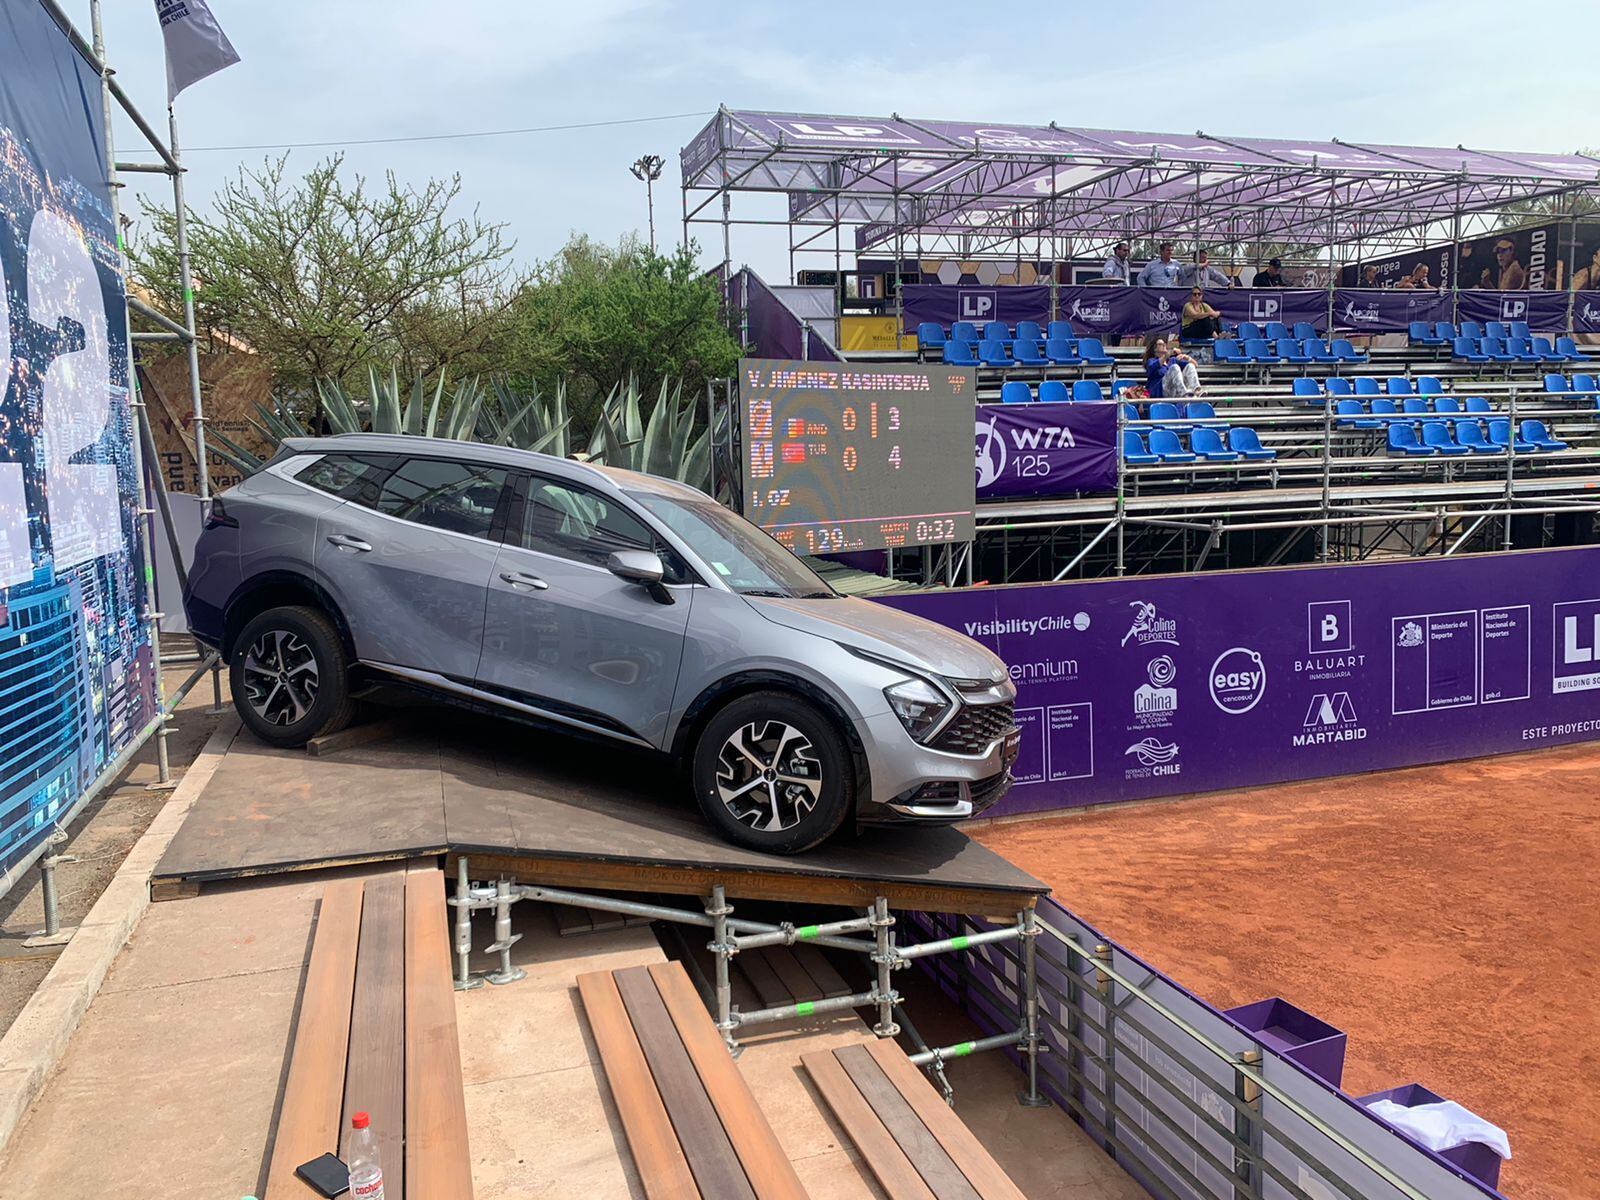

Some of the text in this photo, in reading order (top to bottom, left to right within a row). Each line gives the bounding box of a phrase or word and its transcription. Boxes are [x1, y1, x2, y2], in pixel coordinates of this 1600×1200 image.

[171, 9, 190, 21] CHILE
[790, 123, 884, 137] LP
[963, 297, 992, 316] LP
[1254, 300, 1278, 318] LP
[1503, 301, 1525, 318] LP
[1150, 311, 1178, 321] INDISA
[769, 371, 838, 390] JIMENEZ
[842, 407, 856, 431] 0
[888, 407, 900, 431] 3
[1011, 427, 1075, 449] WTA
[843, 446, 857, 470] 0
[887, 446, 901, 470] 4
[1012, 455, 1050, 477] 125
[767, 489, 790, 507] OZ
[805, 527, 843, 552] 129
[916, 520, 955, 541] 0:32
[964, 615, 1071, 636] VisibilityChile
[1148, 617, 1176, 632] Colina
[1431, 622, 1458, 630] Ministerio
[1485, 621, 1508, 629] Nacional
[1138, 631, 1176, 642] DEPORTES
[1431, 632, 1453, 640] Deporte
[1485, 630, 1509, 639] Deportes
[1006, 658, 1078, 679] ennium
[1294, 655, 1366, 672] BALUART
[1214, 671, 1261, 690] easy
[1309, 671, 1352, 680] INMOBILIARIA
[1557, 678, 1591, 689] BUILDING
[1136, 692, 1171, 712] Colina
[1223, 693, 1253, 703] cencosud
[1303, 722, 1358, 733] INMOBILIARIA
[1522, 719, 1600, 740] ESTE PROYECTO
[1292, 728, 1367, 747] MARTABID
[1153, 764, 1180, 776] CHILE
